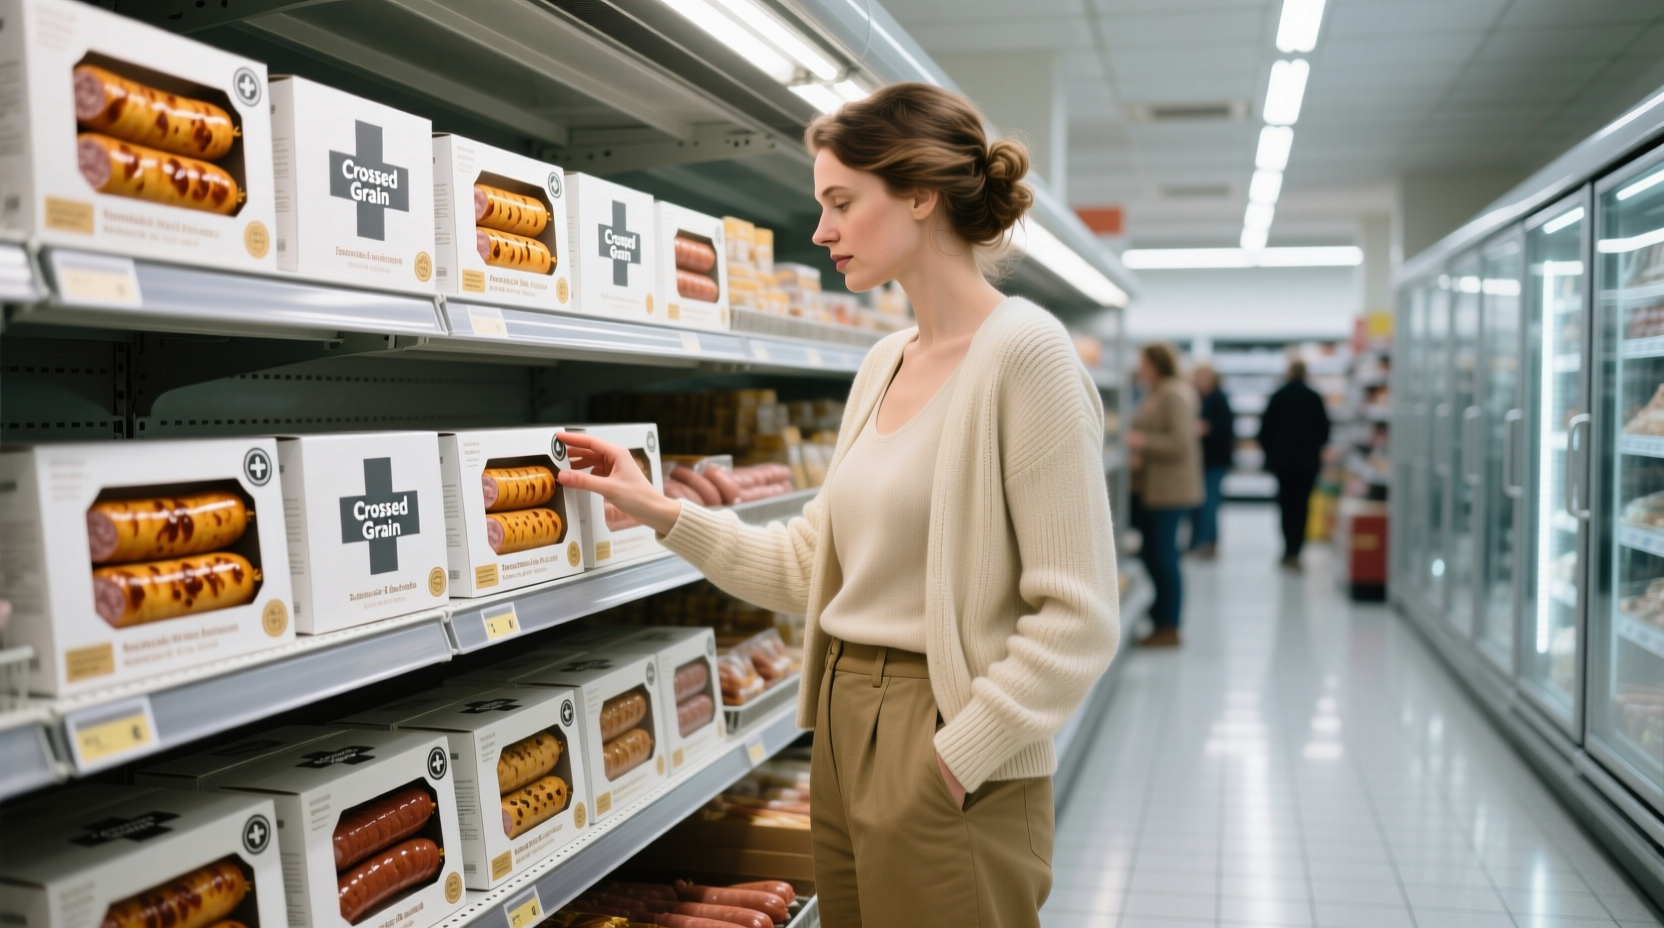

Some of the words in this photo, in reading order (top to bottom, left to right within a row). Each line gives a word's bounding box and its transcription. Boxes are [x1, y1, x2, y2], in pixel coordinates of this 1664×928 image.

[342, 158, 398, 189] Crossed
[350, 181, 390, 206] Grain
[353, 494, 409, 521] Crossed
[362, 518, 402, 540] Grain
